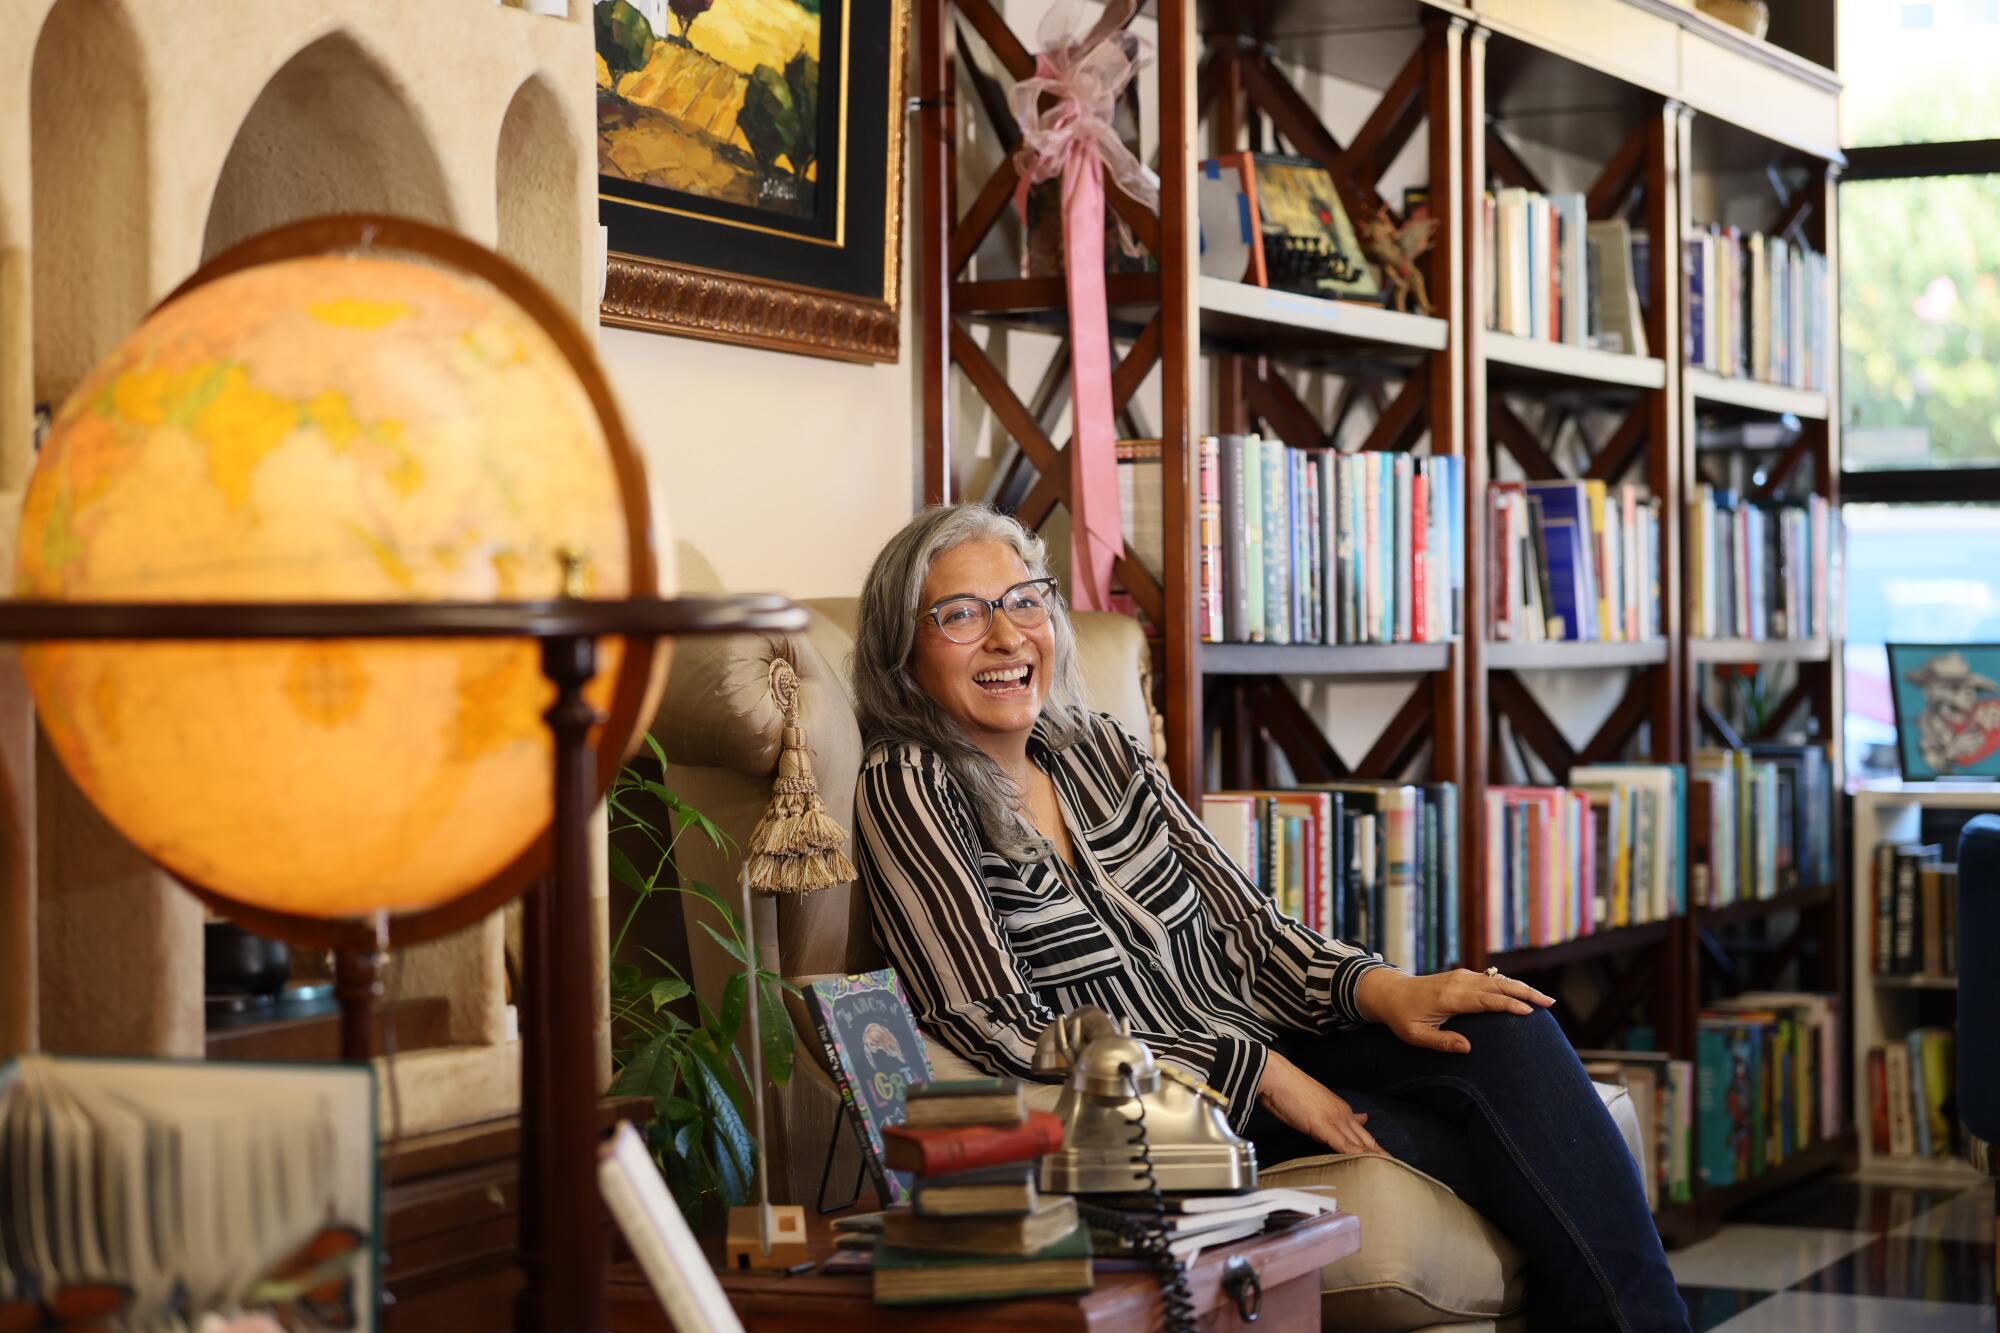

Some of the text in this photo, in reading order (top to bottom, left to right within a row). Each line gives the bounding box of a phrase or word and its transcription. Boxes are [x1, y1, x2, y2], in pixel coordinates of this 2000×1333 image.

[817, 1024, 828, 1041] The
[824, 1043, 840, 1070] ABC's
[835, 1071, 845, 1082] of
